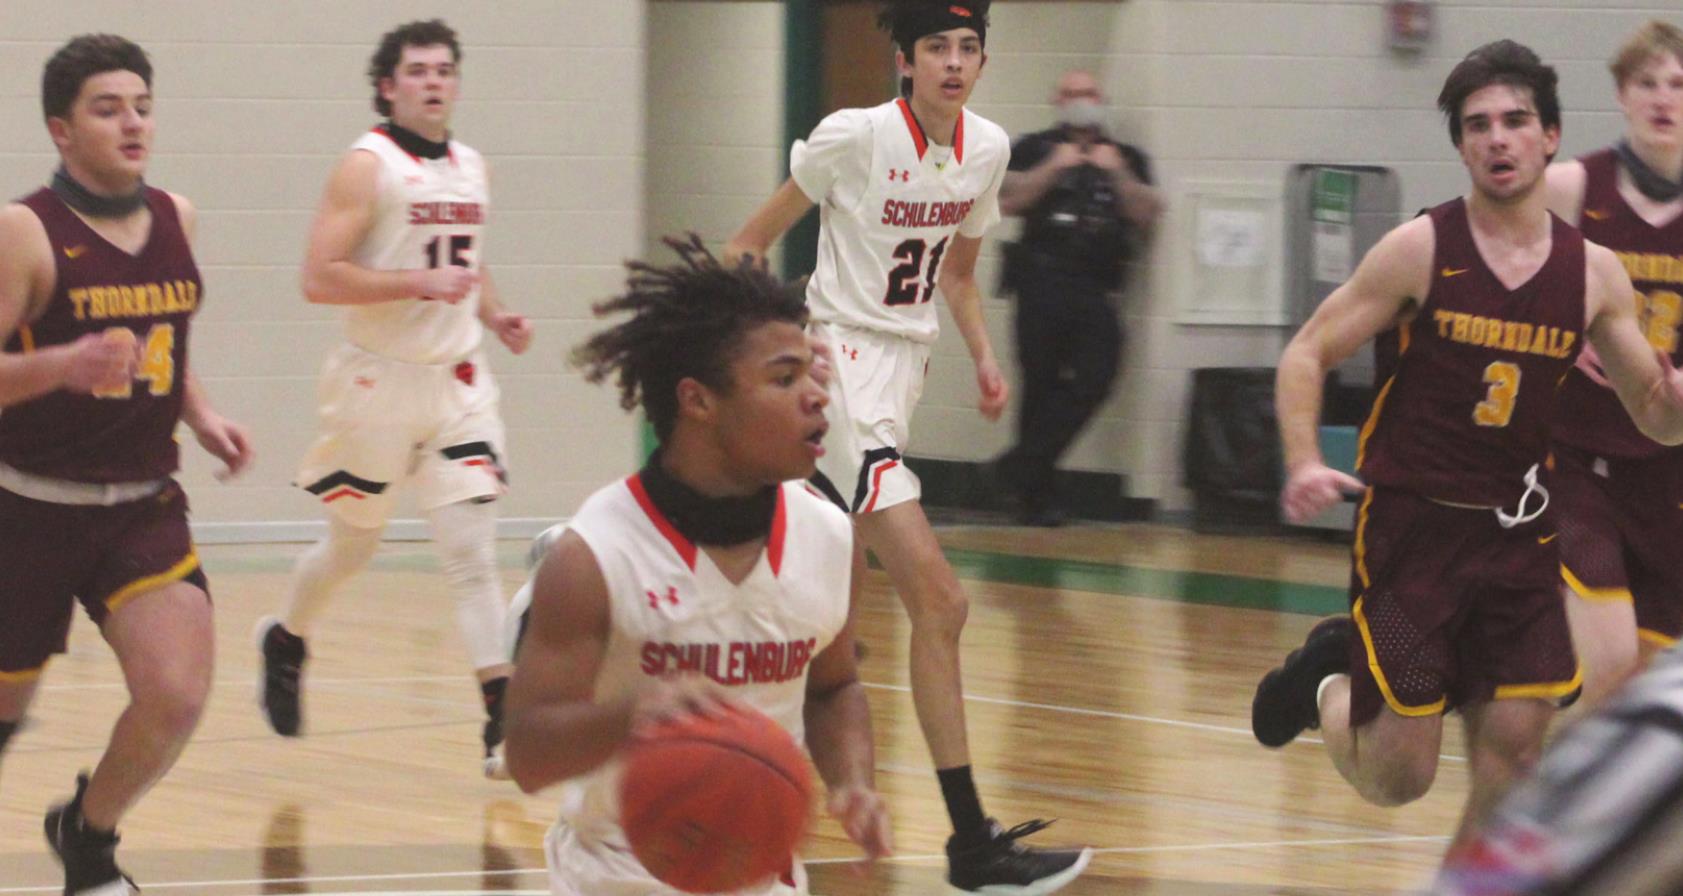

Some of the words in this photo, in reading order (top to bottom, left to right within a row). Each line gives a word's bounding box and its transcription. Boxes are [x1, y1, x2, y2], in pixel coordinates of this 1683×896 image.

[883, 235, 949, 306] 21
[1433, 308, 1577, 359] THORNDALE
[1472, 360, 1522, 428] 3
